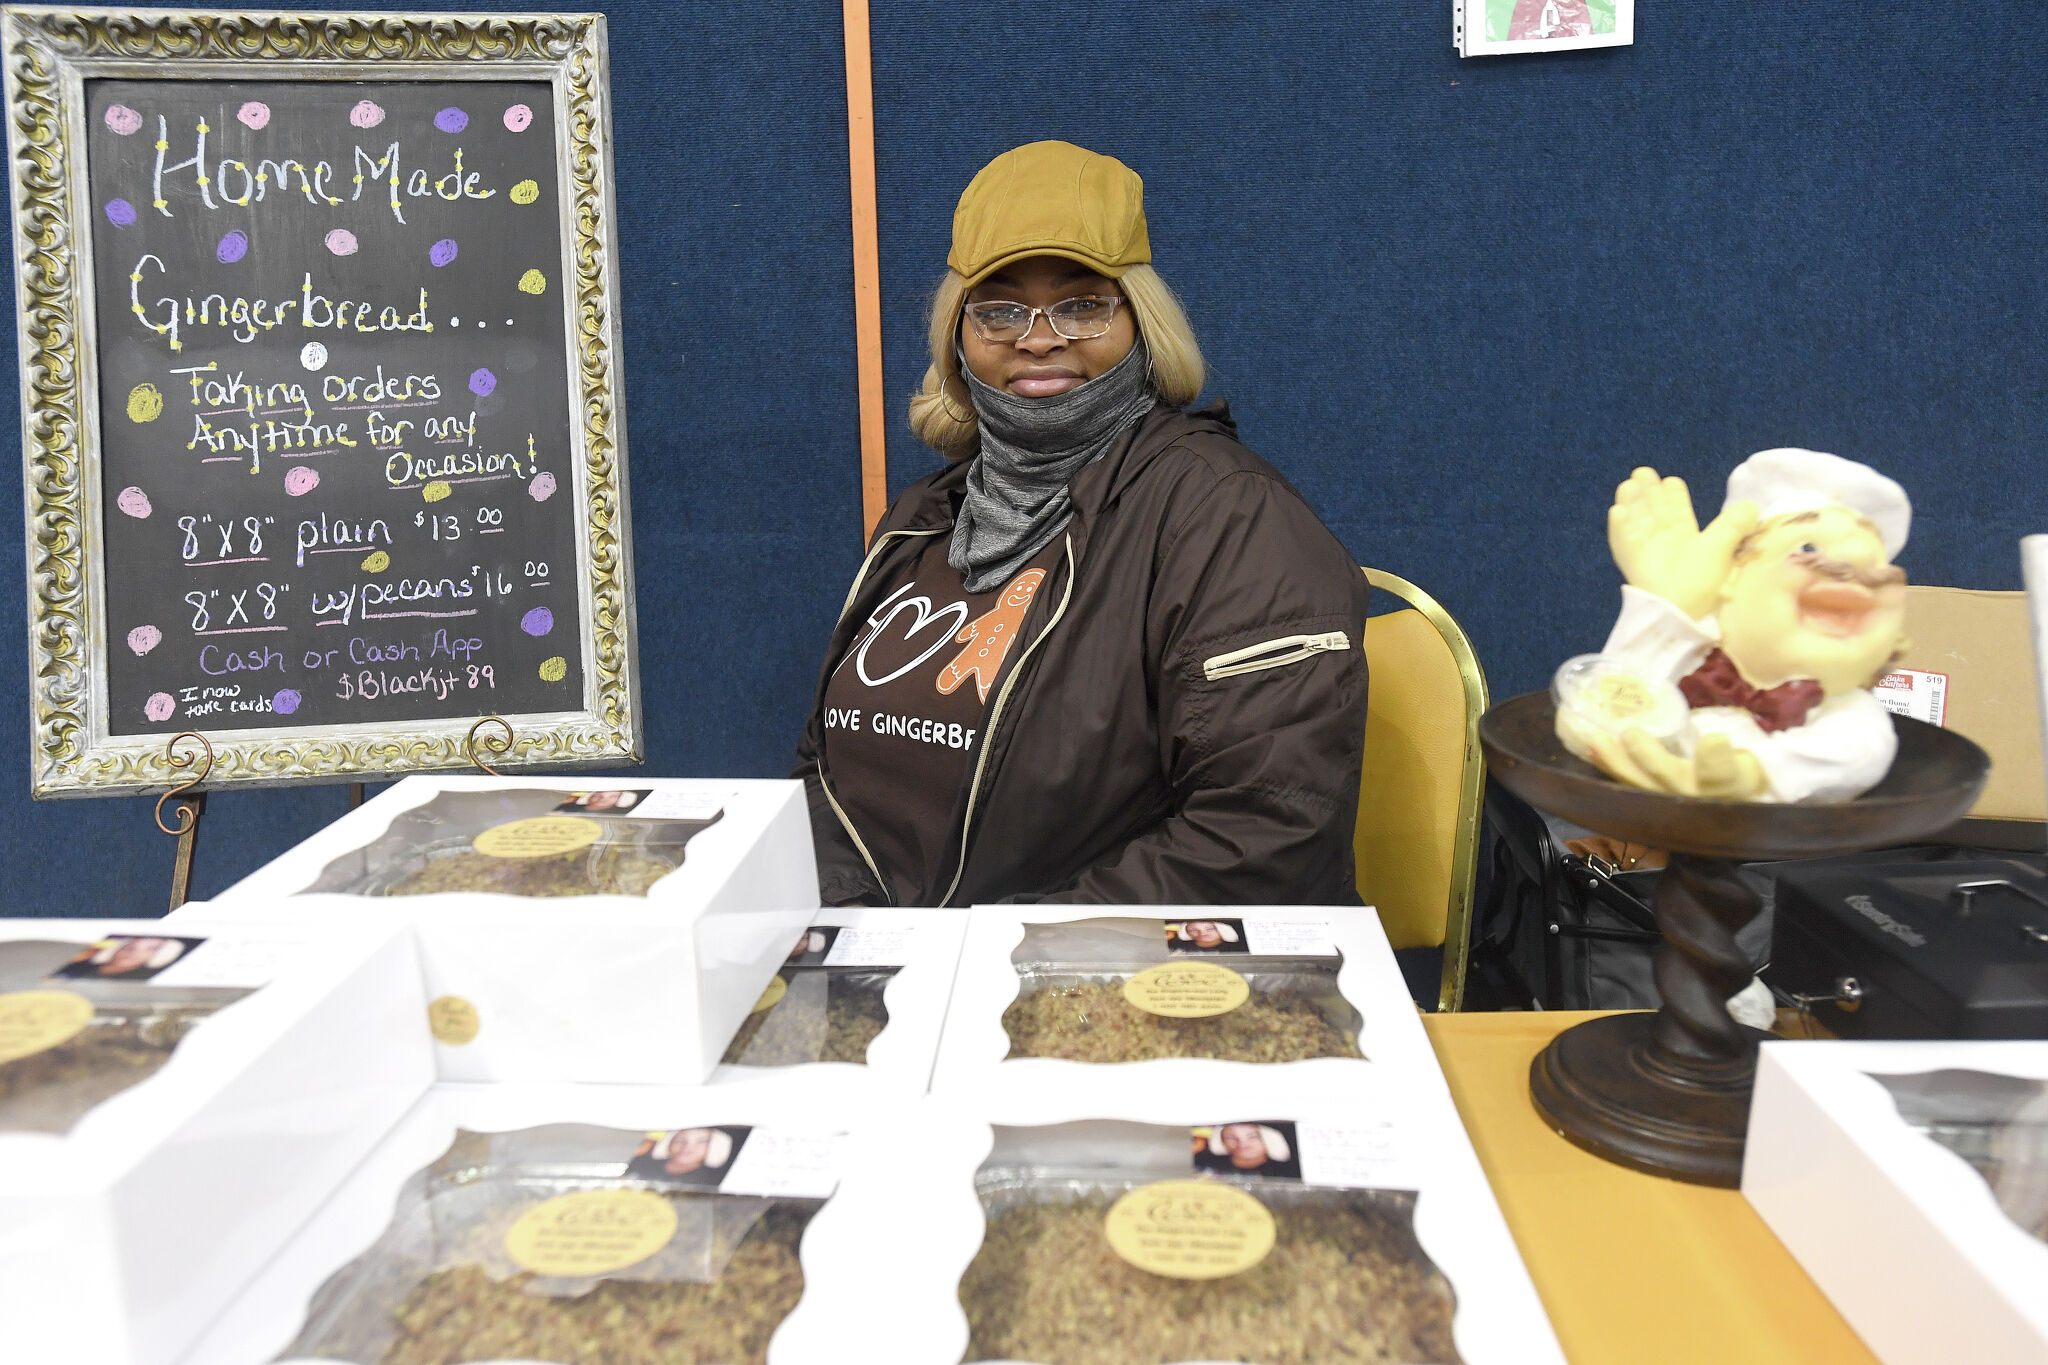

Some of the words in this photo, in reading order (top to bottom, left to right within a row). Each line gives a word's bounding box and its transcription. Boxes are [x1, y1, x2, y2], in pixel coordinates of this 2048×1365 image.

[170, 361, 313, 428] Taking
[323, 365, 442, 402] orders
[187, 414, 357, 474] Anytime
[366, 411, 414, 446] for
[424, 411, 477, 447] any
[296, 512, 393, 568] plain
[200, 645, 286, 675] Cash
[303, 650, 339, 669] or
[349, 637, 421, 664] Cash
[430, 629, 483, 661] App
[179, 686, 199, 703] I
[203, 684, 241, 700] now
[1926, 675, 1942, 685] 519
[184, 700, 223, 718] take
[230, 695, 273, 713] cards
